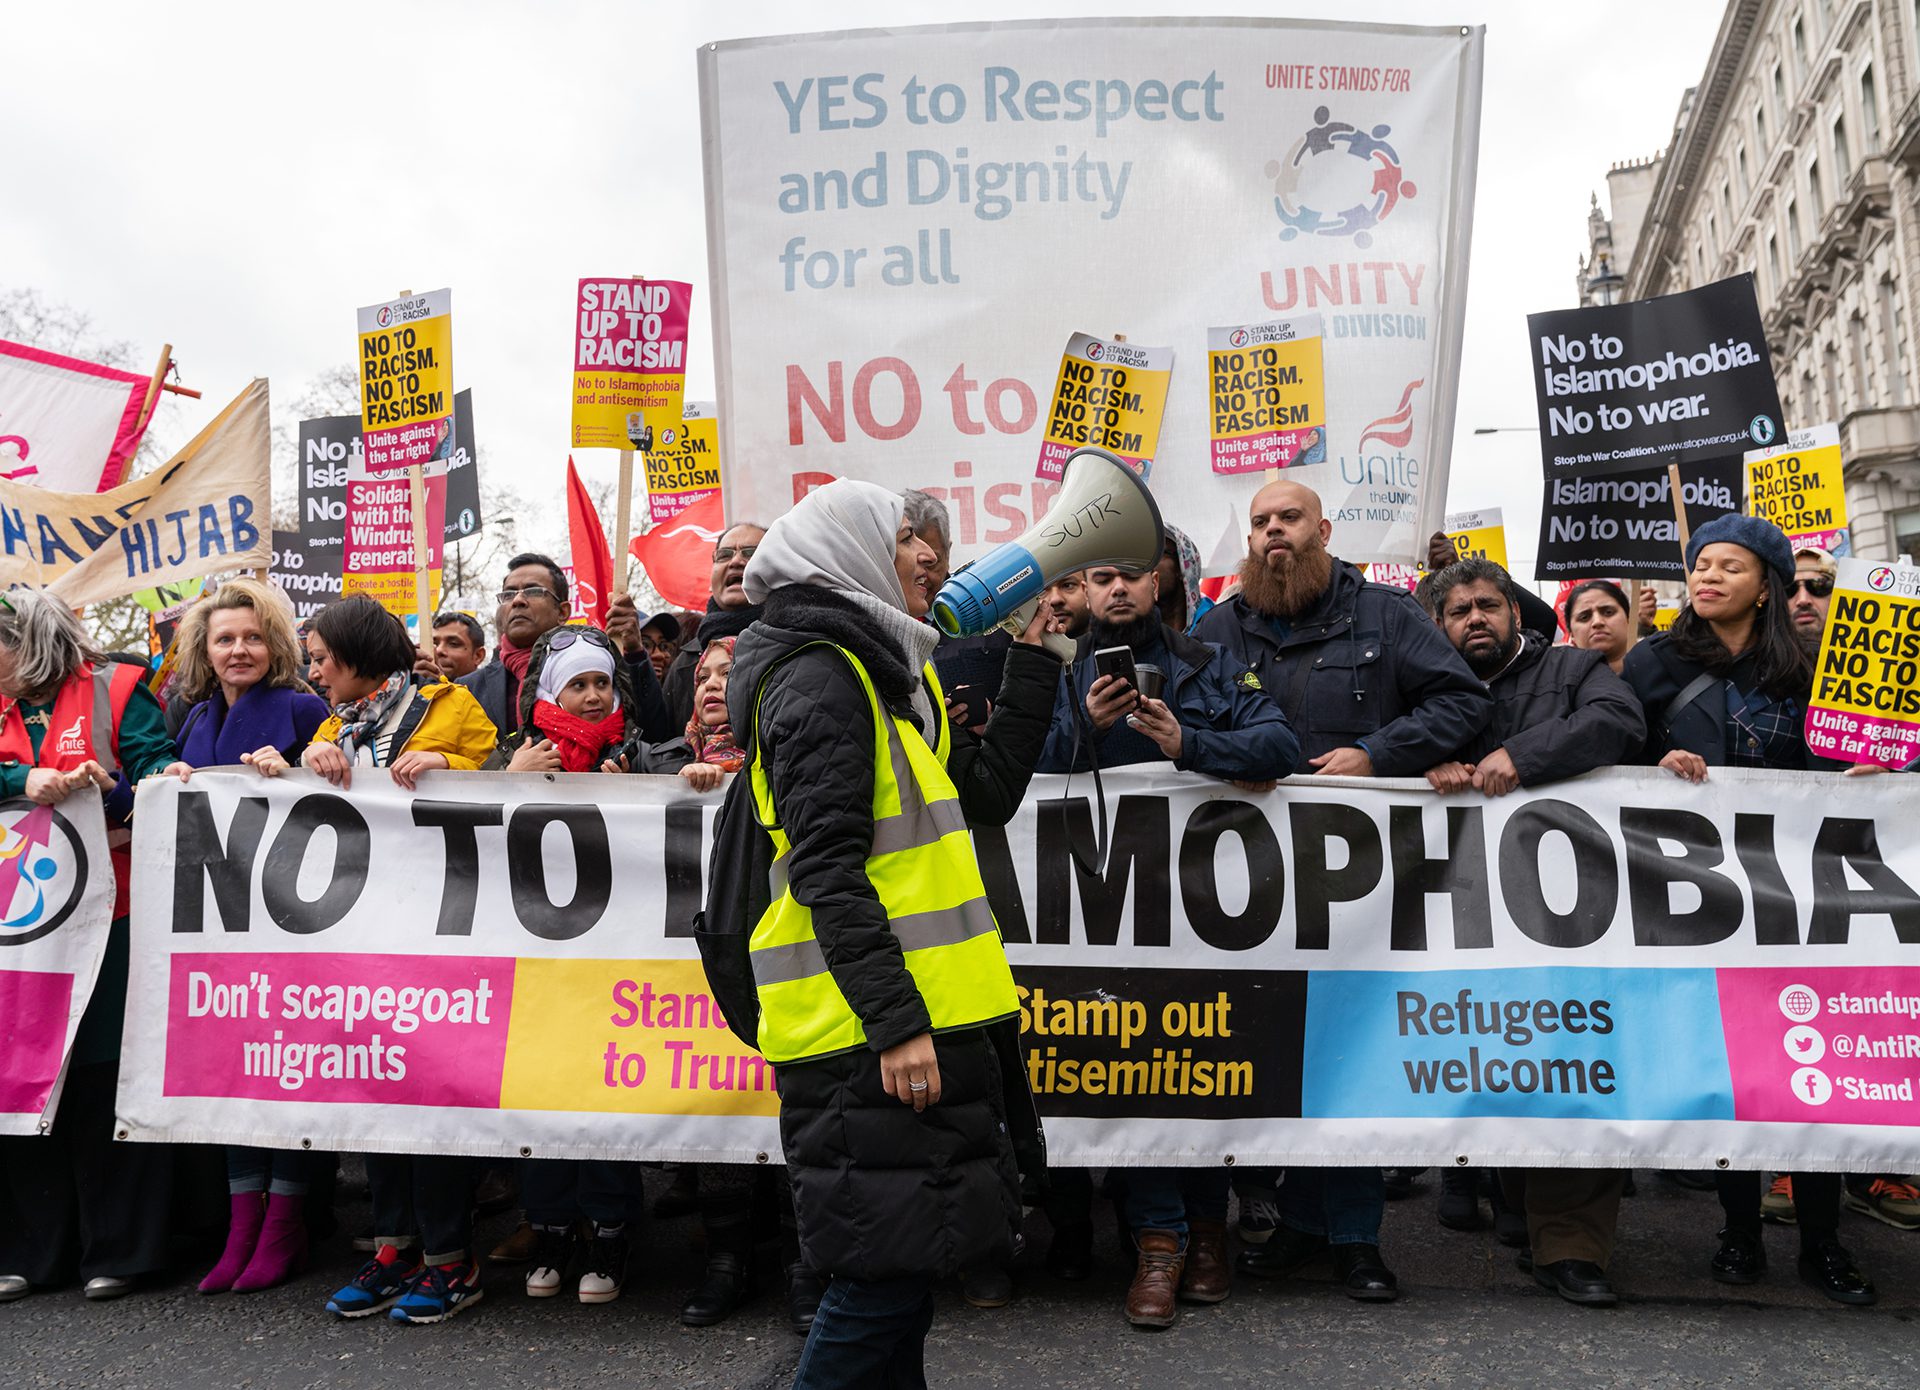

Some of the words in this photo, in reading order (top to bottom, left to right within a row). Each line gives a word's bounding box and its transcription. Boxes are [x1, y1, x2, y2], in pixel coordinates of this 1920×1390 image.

[1265, 64, 1314, 89] UNITE
[1319, 65, 1380, 92] STANDS
[1381, 68, 1411, 92] FOR
[773, 72, 888, 135] YES
[900, 73, 966, 125] to
[983, 65, 1225, 138] Respect
[778, 151, 888, 214] and
[905, 144, 1134, 221] Dignity
[778, 236, 868, 292] for
[880, 228, 960, 287] all
[581, 283, 670, 313] STAND
[1260, 261, 1426, 311] UNITY
[393, 300, 414, 312] STAND
[415, 299, 426, 308] UP
[402, 307, 431, 321] RACISM
[580, 311, 619, 338] UP
[625, 312, 662, 341] TO
[1250, 325, 1276, 336] STAND
[1279, 323, 1291, 332] UP
[1251, 335, 1261, 343] TO
[1263, 331, 1295, 342] RACISM
[1332, 313, 1427, 341] DIVISION
[363, 335, 390, 358] NO
[393, 328, 416, 351] TO
[578, 338, 682, 368] RACISM
[1107, 345, 1132, 357] STAND
[1134, 350, 1146, 359] UP
[1541, 334, 1586, 365] No
[1590, 333, 1624, 360] to
[365, 347, 438, 380] RACISM,
[1063, 361, 1094, 383] NO
[1100, 368, 1127, 388] TO
[1117, 356, 1148, 368] RACISM
[1214, 354, 1244, 374] NO
[1249, 348, 1278, 369] TO
[1544, 338, 1760, 396] Islamophobia.
[366, 380, 393, 403] NO
[398, 373, 420, 396] TO
[577, 377, 591, 389] No
[595, 377, 605, 389] to
[609, 377, 680, 394] Islamophobia
[1214, 365, 1303, 394] RACISM,
[367, 391, 443, 425] FASCISM
[576, 392, 595, 404] and
[598, 393, 668, 407] antisemitism
[785, 356, 922, 446] NO
[942, 362, 1038, 435] to
[1059, 380, 1144, 415] RACISM,
[1215, 393, 1246, 414] NO
[1252, 387, 1280, 408] TO
[1054, 401, 1085, 422] NO
[1092, 407, 1119, 428] TO
[1216, 404, 1309, 434] FASCISM
[1549, 406, 1593, 437] No
[1597, 403, 1633, 432] to
[1637, 393, 1710, 426] war.
[368, 432, 398, 448] Unite
[400, 424, 436, 444] against
[1050, 419, 1142, 453] FASCISM
[1216, 440, 1249, 455] Unite
[1252, 432, 1297, 451] against
[1554, 455, 1577, 466] Stop
[1577, 453, 1592, 463] the
[1592, 451, 1610, 462] War
[1611, 445, 1657, 459] Coalition.
[1657, 430, 1750, 453] www.stopwar.org.uk
[1786, 439, 1816, 450] RACISM
[1800, 432, 1811, 441] UP
[306, 437, 346, 463] No
[369, 450, 388, 464] the
[390, 446, 405, 461] far
[405, 441, 430, 460] right
[1045, 444, 1072, 459] Unit
[1216, 455, 1237, 468] the
[1240, 453, 1257, 466] far
[1261, 448, 1290, 464] right
[646, 457, 669, 473] NO
[673, 456, 696, 472] TO
[1042, 460, 1063, 473] the
[1340, 451, 1419, 488] unite
[1752, 463, 1773, 483] NO
[1777, 457, 1800, 476] TO
[649, 469, 720, 489] FASCISM
[1754, 472, 1825, 501] RACISM,
[307, 496, 347, 522] No
[651, 495, 677, 506] Unite
[653, 507, 669, 518] the
[1754, 500, 1777, 518] NO
[1781, 494, 1805, 512] TO
[352, 506, 388, 525] with
[1040, 492, 1121, 547] SUTR
[1329, 508, 1362, 521] EAST
[1367, 508, 1417, 525] MIDLANDS
[1457, 520, 1483, 529] RACISM
[1549, 515, 1585, 543] No
[1589, 514, 1618, 540] to
[121, 495, 260, 578] HIJAB
[309, 538, 327, 547] Stop
[328, 536, 342, 545] the
[351, 525, 416, 546] Windru
[283, 549, 304, 569] to
[348, 547, 434, 570] generatn
[1546, 561, 1566, 571] Stop
[1567, 560, 1578, 569] the
[1579, 559, 1593, 568] War
[1593, 557, 1634, 567] Coalition.
[1636, 560, 1684, 570] www.stopw
[348, 578, 378, 589] Create
[998, 569, 1030, 592] MONACOR
[1898, 583, 1912, 594] TO
[1899, 571, 1920, 583] STA
[404, 589, 415, 599] for
[1835, 596, 1880, 625] NO
[1889, 603, 1920, 632] TO
[1829, 622, 1920, 661] RACIS
[1824, 649, 1869, 678] NO
[1879, 658, 1917, 686] TO
[1818, 676, 1920, 715] FASCIS
[1812, 710, 1858, 733] Unite
[1862, 718, 1920, 745] against
[56, 738, 86, 752] unite
[1809, 729, 1836, 749] the
[1841, 736, 1866, 755] far
[1868, 739, 1909, 762] right
[172, 792, 371, 935] NO
[411, 799, 613, 941] TO
[188, 971, 272, 1019] Don't
[281, 978, 493, 1034] scapegoat
[1827, 991, 1920, 1020] standup
[1017, 985, 1147, 1048] Stamp
[1162, 992, 1231, 1038] out
[1396, 989, 1614, 1046] Refugees
[1832, 1034, 1920, 1058] @AntiR
[243, 1030, 407, 1090] migrants
[603, 1042, 646, 1088] to
[664, 1041, 777, 1091] Trum
[1028, 1047, 1253, 1096] tisemitism
[1403, 1047, 1617, 1095] welcome
